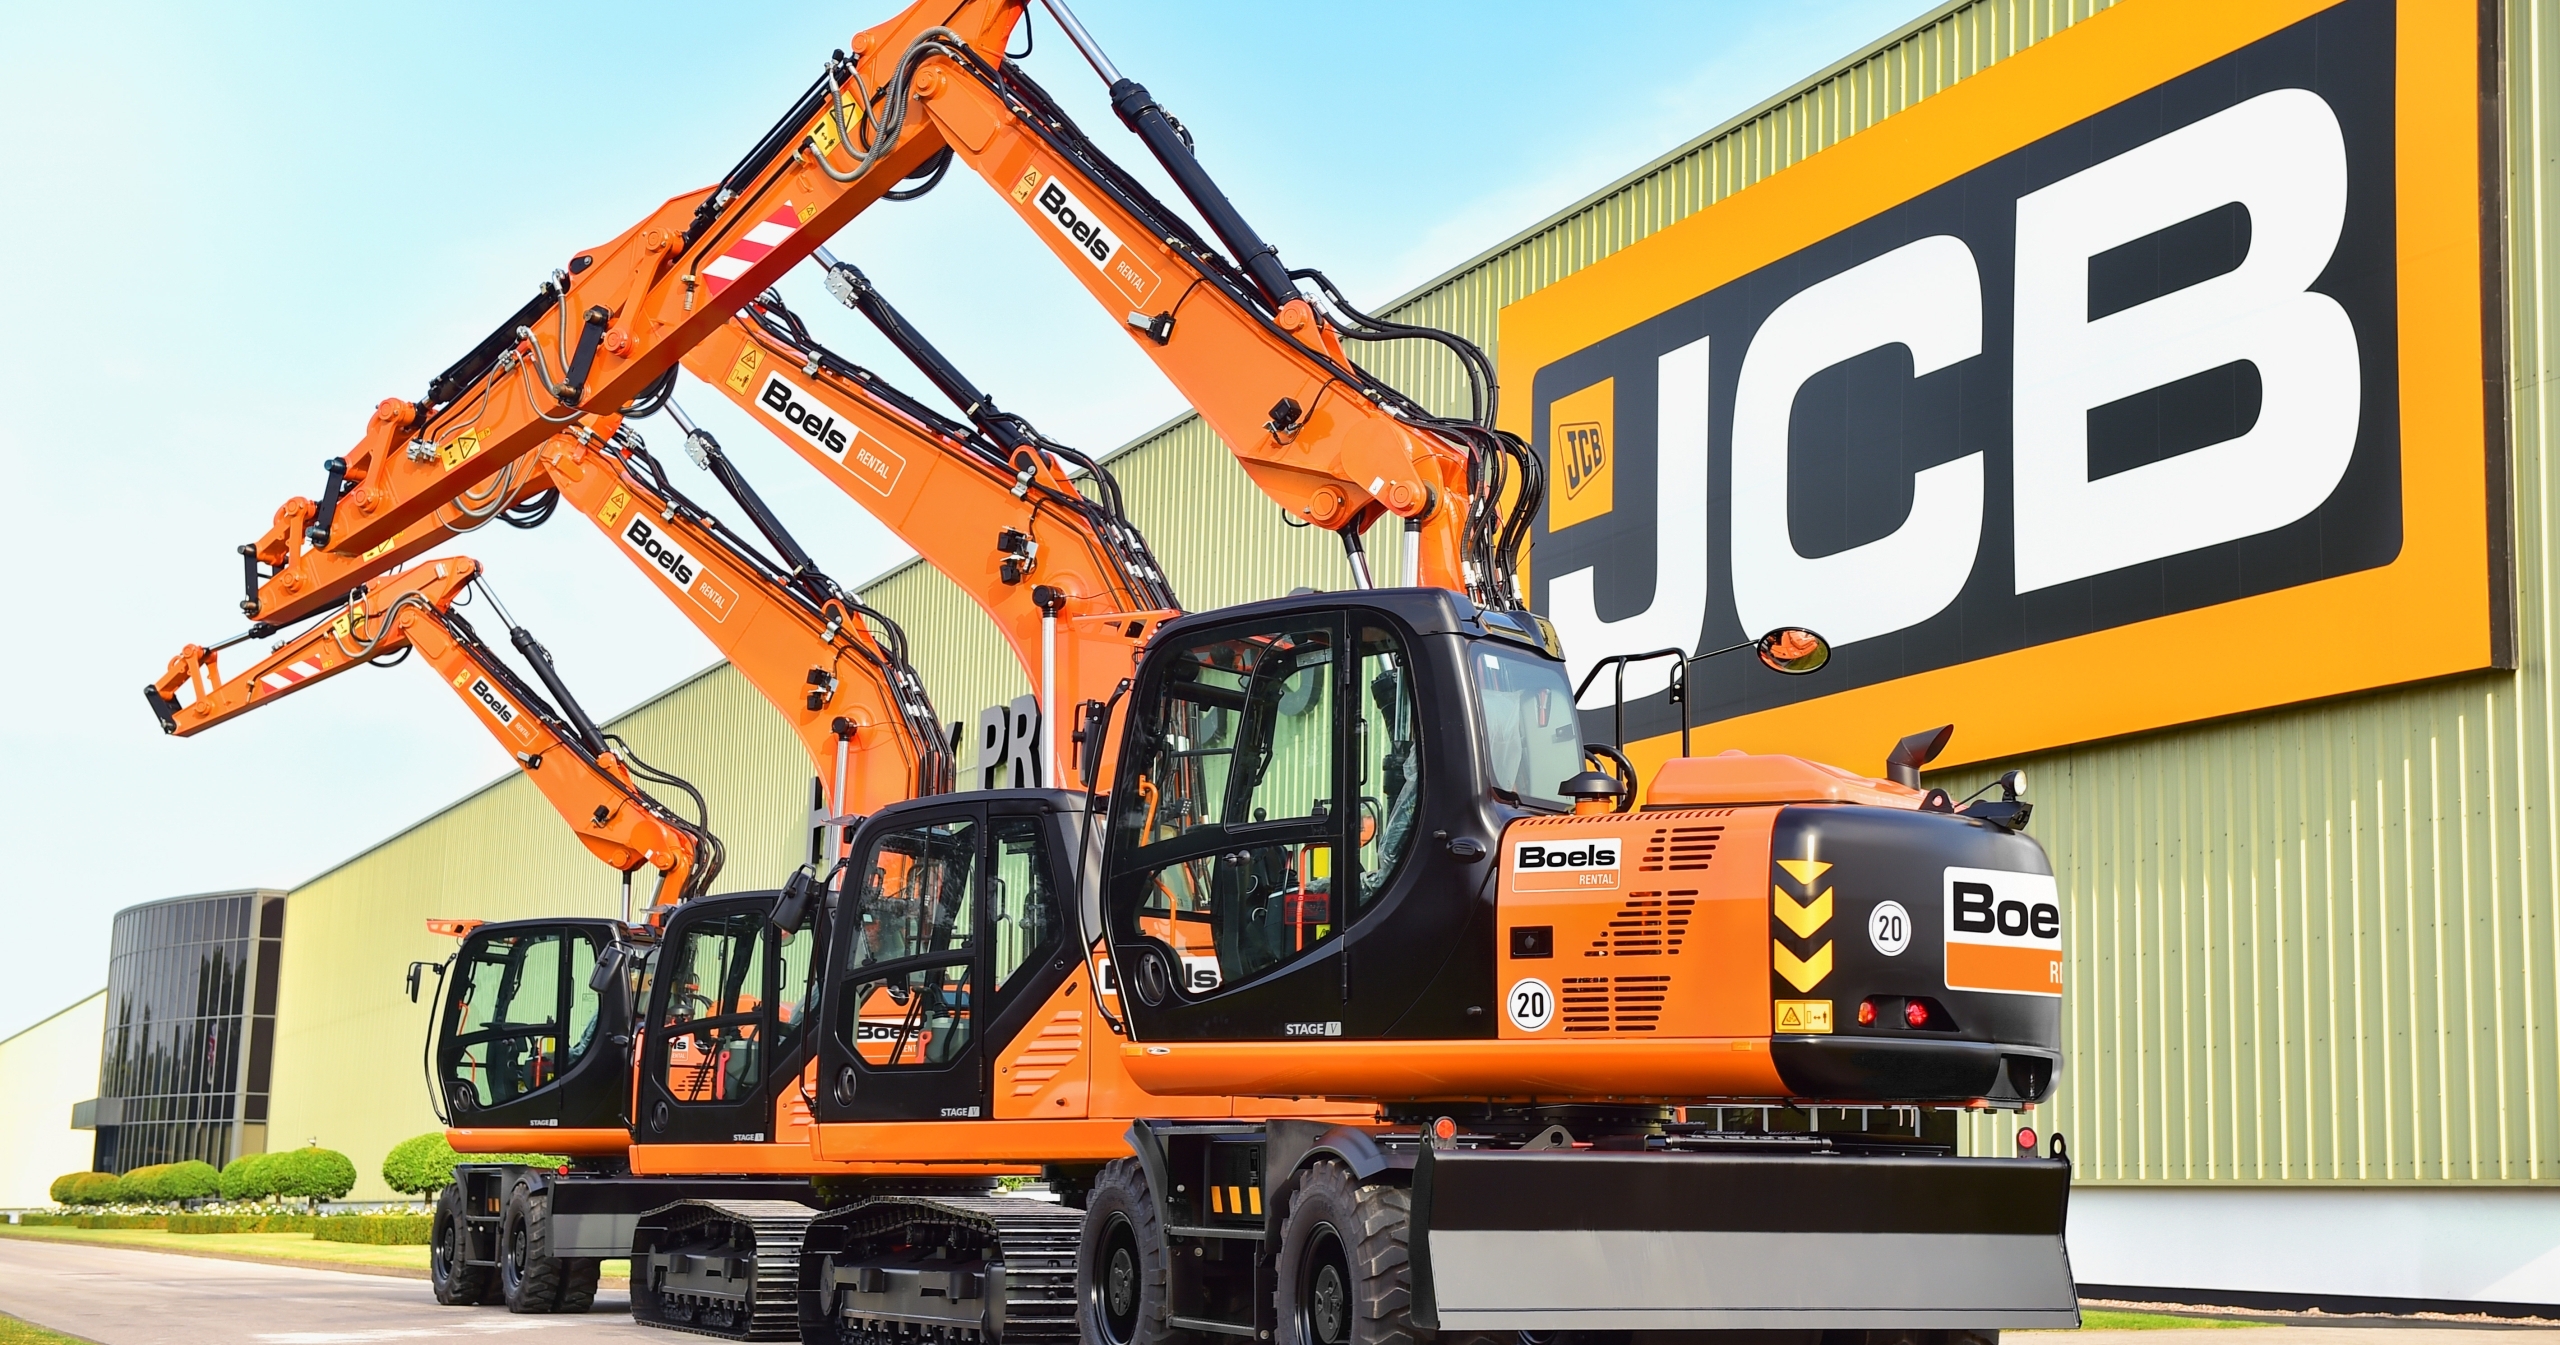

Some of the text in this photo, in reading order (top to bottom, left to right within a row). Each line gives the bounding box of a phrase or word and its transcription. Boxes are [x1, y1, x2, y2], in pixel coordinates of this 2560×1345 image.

[1039, 183, 1146, 293] Boels RENTAL
[1547, 88, 2361, 712] JCB
[762, 378, 890, 480] Boels RENTAL
[1567, 428, 1602, 490] JCB
[627, 518, 726, 609] Boels RENTAL
[472, 679, 531, 740] Boels RENTAL
[1519, 845, 1616, 868] Boels
[1579, 874, 1615, 886] RENTAL
[1878, 915, 1902, 942] 20
[1517, 992, 1545, 1018] 20
[1286, 1023, 1324, 1035] STAGE
[940, 1107, 968, 1117] STAGE
[733, 1133, 754, 1141] STAGE
